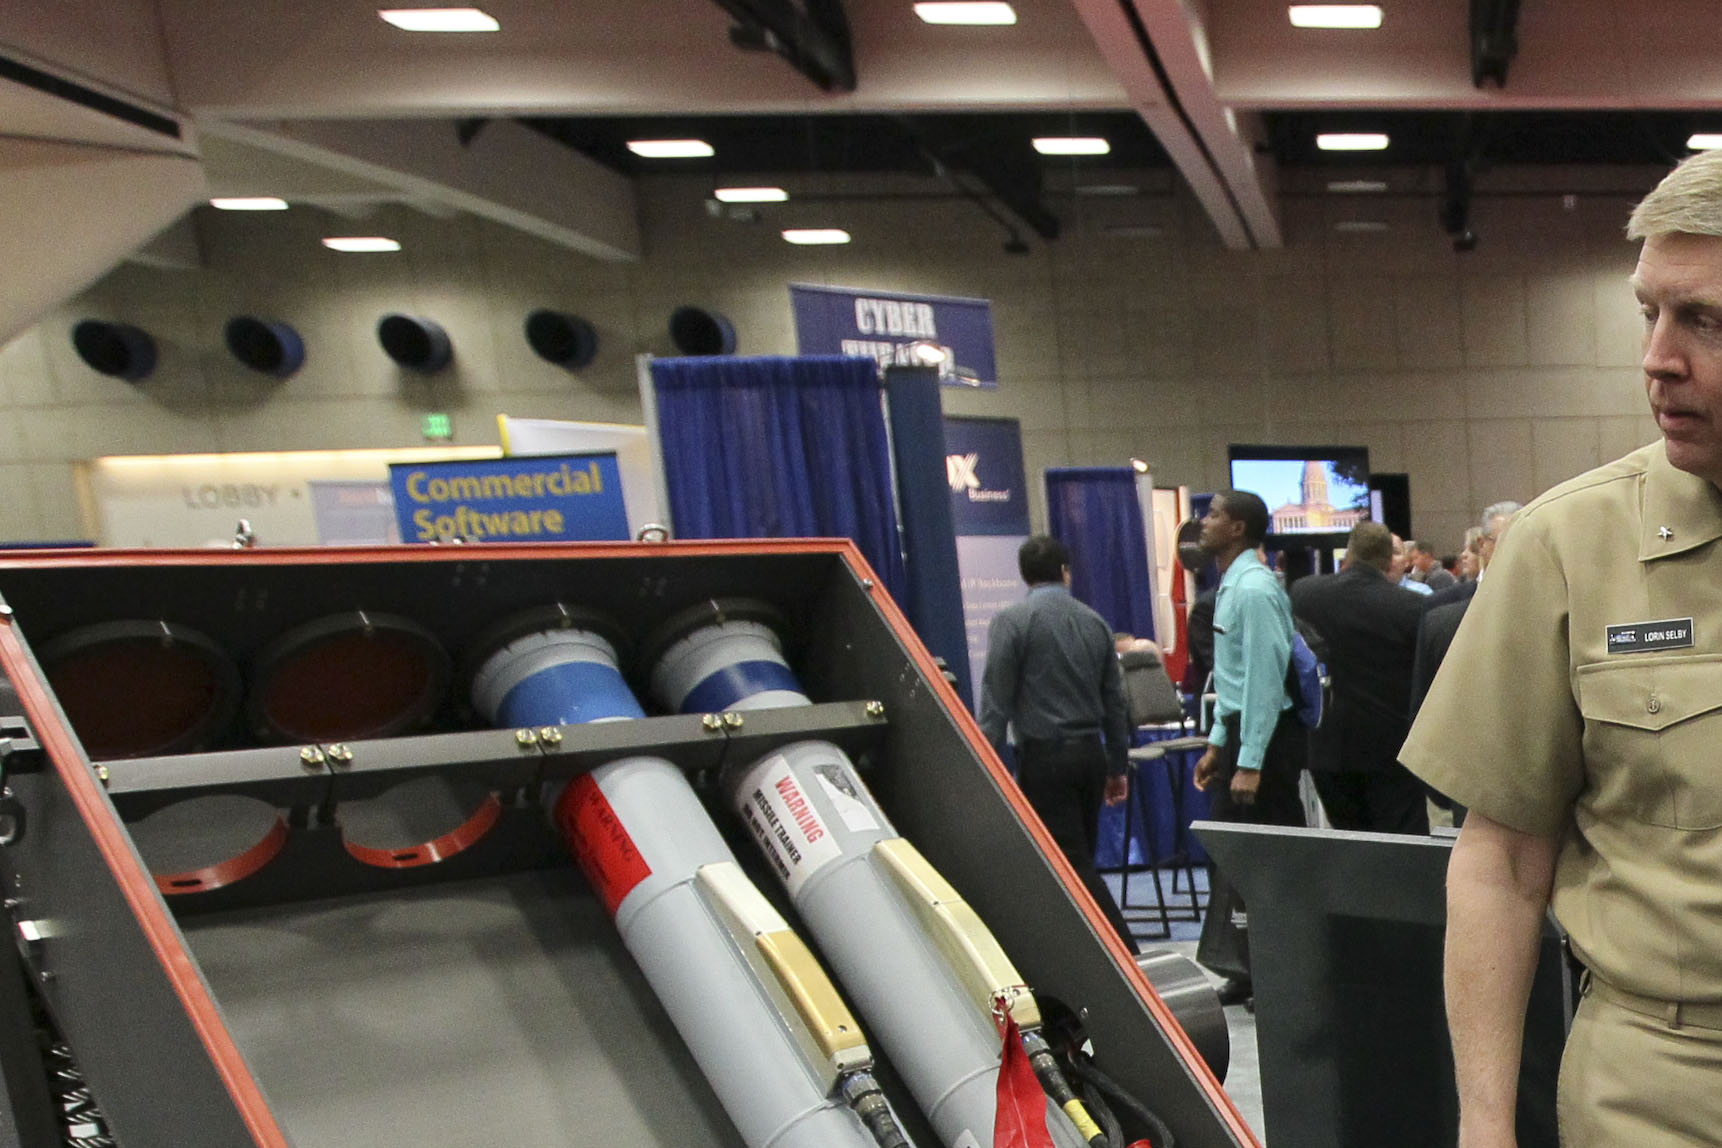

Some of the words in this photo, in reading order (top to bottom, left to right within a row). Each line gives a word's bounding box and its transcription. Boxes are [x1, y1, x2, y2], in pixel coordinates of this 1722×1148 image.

[855, 298, 936, 338] CYBER
[183, 482, 277, 510] LOBBY
[406, 462, 600, 501] Commercial
[413, 505, 564, 540] Software
[1644, 631, 1665, 643] LORIN
[1665, 629, 1687, 640] SELBY
[752, 788, 779, 828] MISSILE
[774, 822, 802, 866] TRAINER
[775, 776, 824, 844] WARNING
